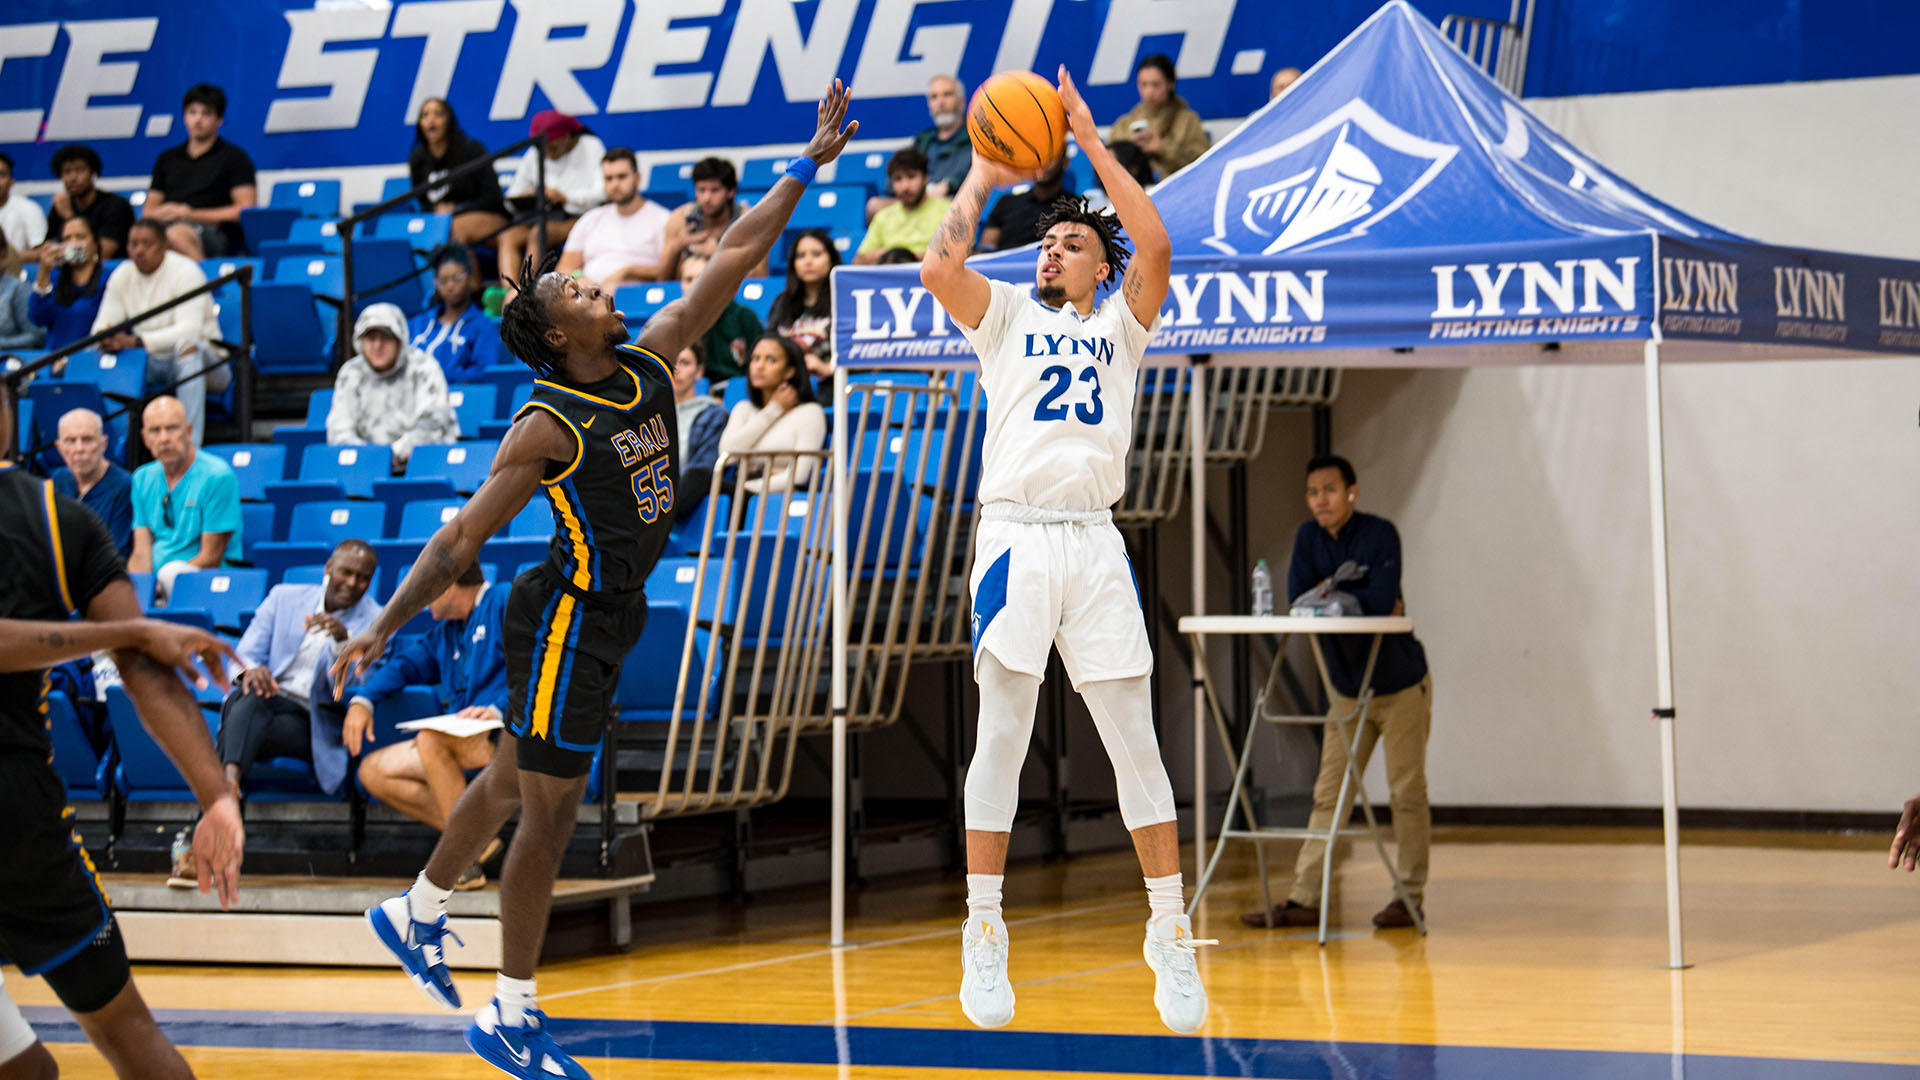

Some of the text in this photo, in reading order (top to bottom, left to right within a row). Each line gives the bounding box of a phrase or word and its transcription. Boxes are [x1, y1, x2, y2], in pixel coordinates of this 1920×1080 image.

[851, 286, 950, 340] LY
[1430, 256, 1641, 318] LYNN
[1662, 257, 1738, 314] LYNN
[1773, 266, 1845, 322] LYNN
[848, 339, 943, 359] FIGHTING
[1024, 332, 1115, 366] LYNN
[1149, 325, 1327, 347] GHTING KNIGHTS
[1429, 317, 1535, 339] FIGHTING
[1536, 315, 1640, 336] KNIGHTS
[1033, 365, 1104, 425] 23
[610, 413, 670, 468] ERAU
[630, 453, 675, 525] 55
